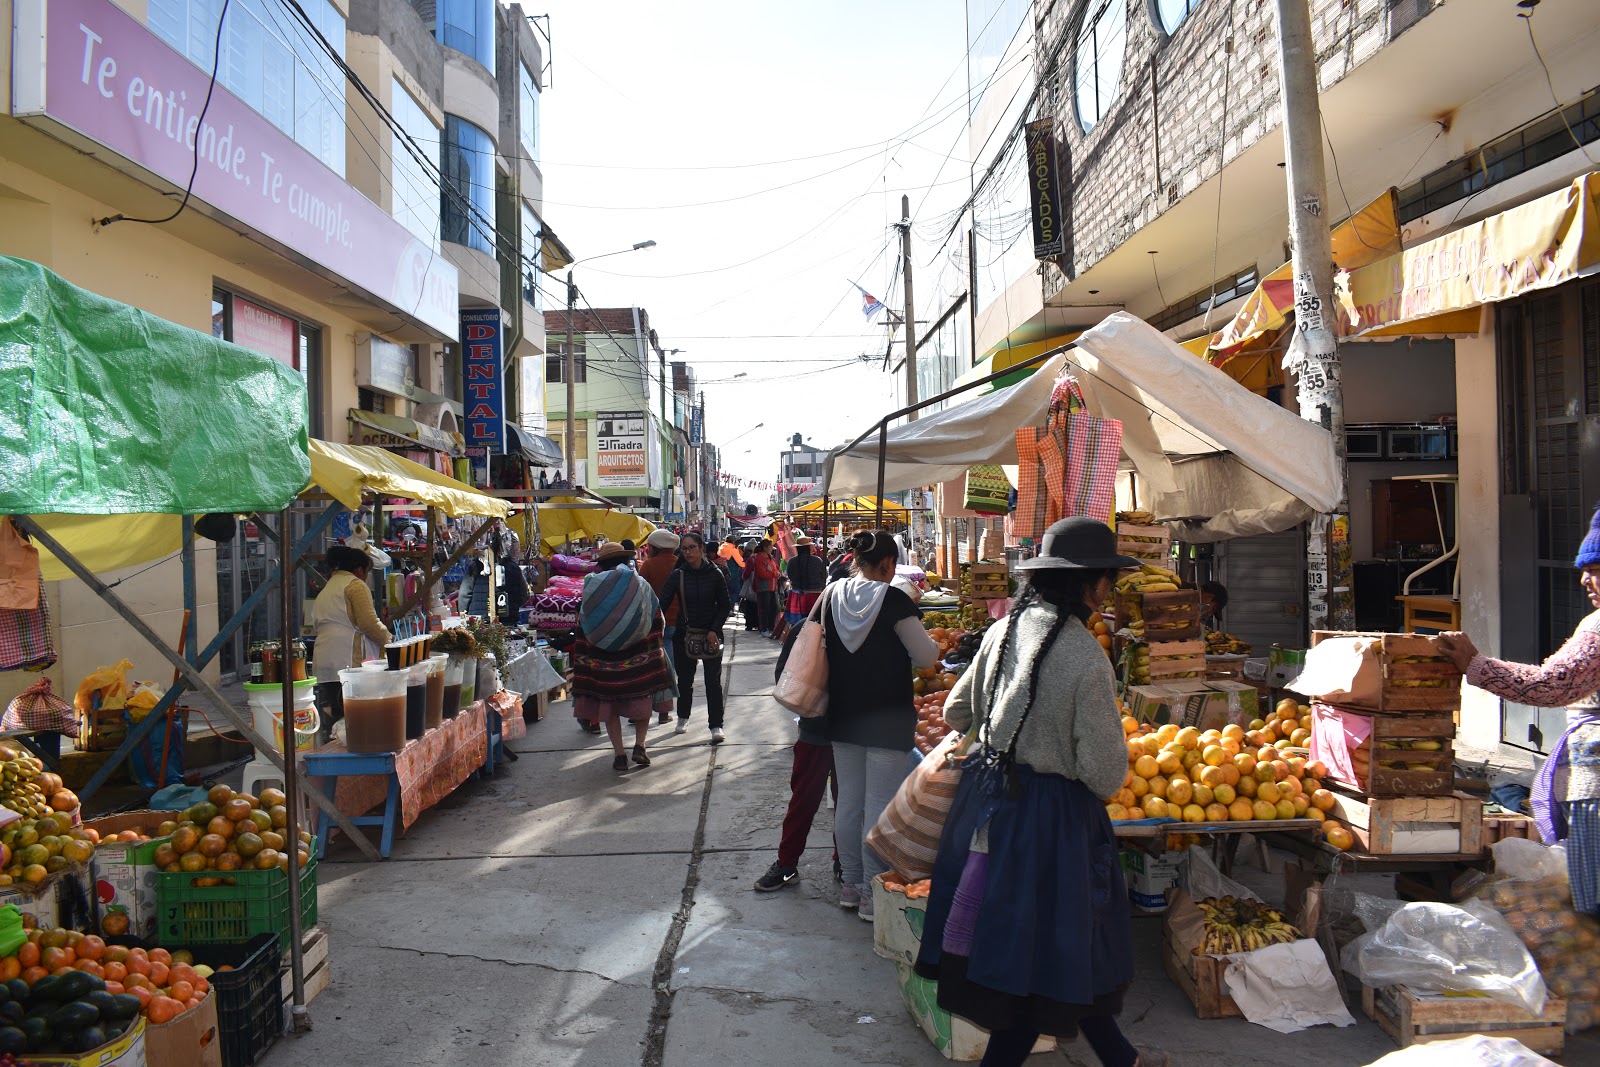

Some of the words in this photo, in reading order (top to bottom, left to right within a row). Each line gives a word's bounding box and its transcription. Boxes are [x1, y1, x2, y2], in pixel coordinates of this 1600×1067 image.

[79, 23, 117, 98] Te
[127, 76, 251, 186] entiende.
[261, 151, 283, 204] Te
[288, 183, 353, 249] cumple.
[1034, 140, 1053, 242] ABOGADOS
[462, 314, 499, 322] CONSULTORIO
[467, 324, 498, 439] DENTAL
[598, 453, 644, 467] ARQUITECTOS
